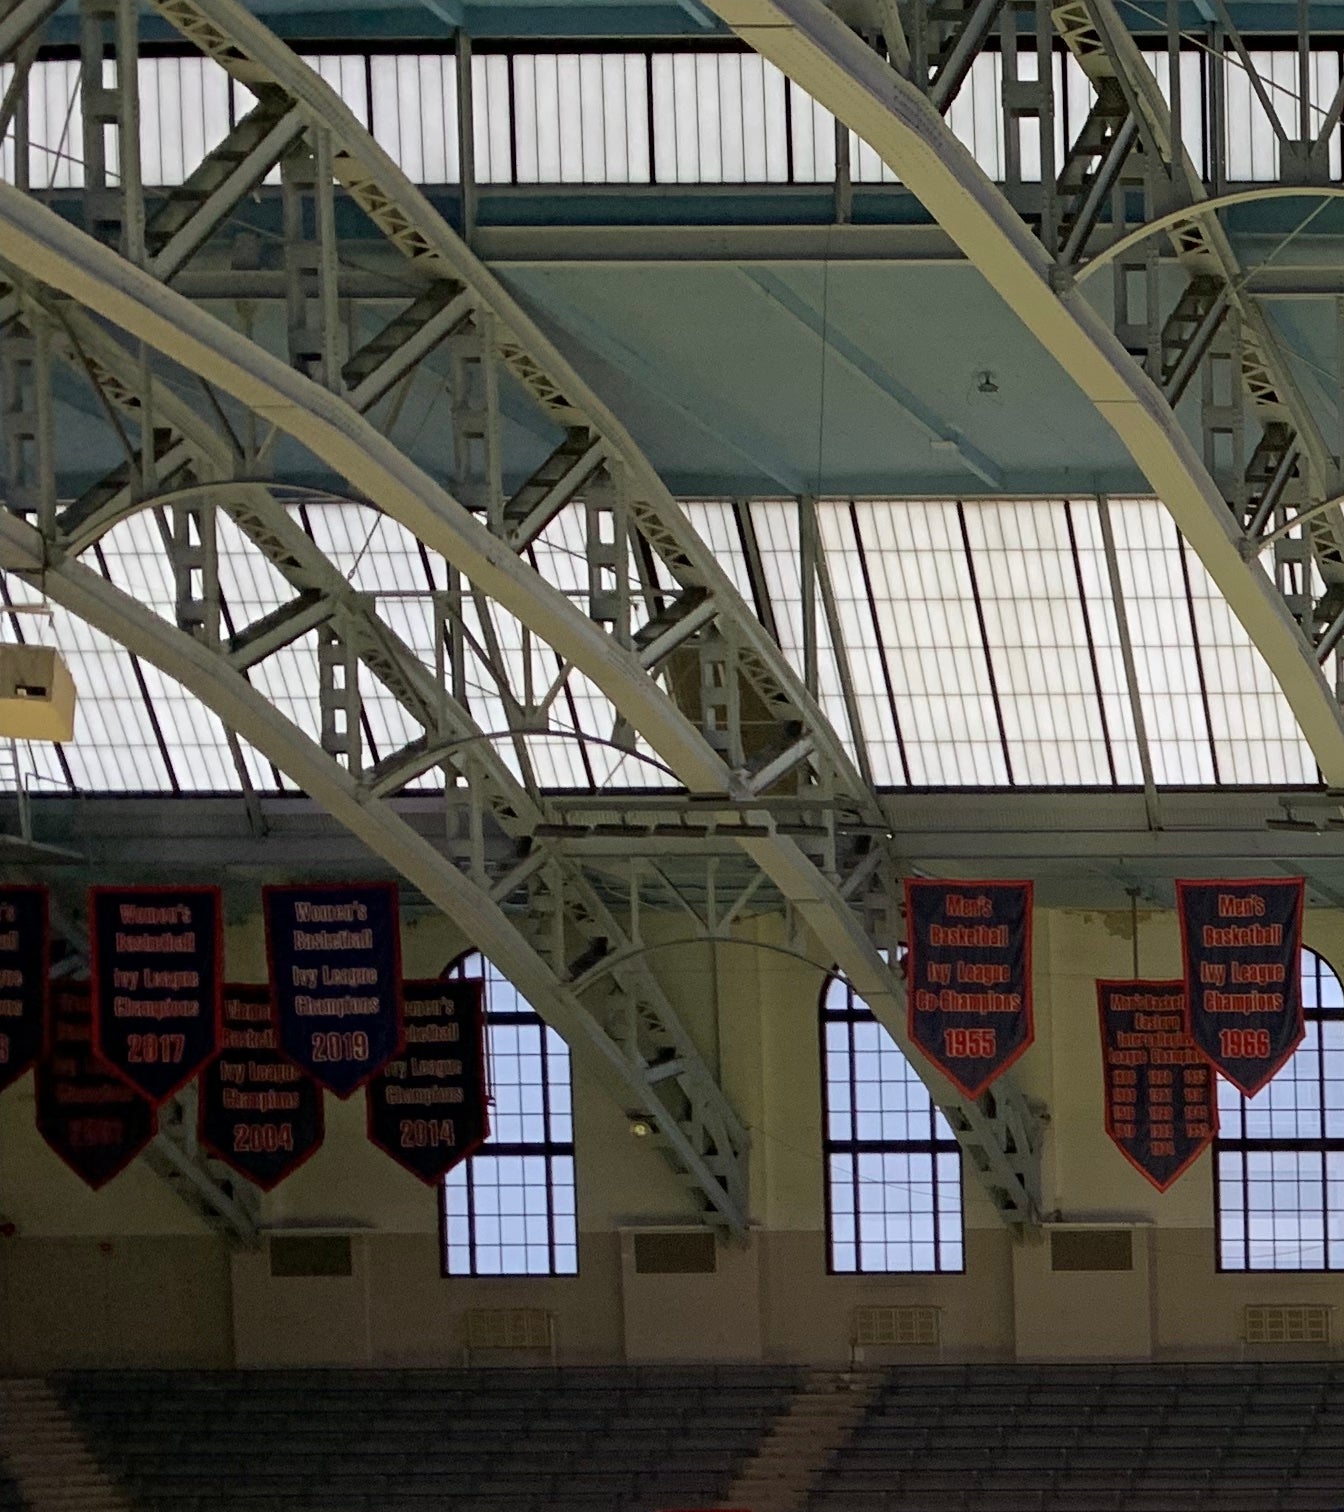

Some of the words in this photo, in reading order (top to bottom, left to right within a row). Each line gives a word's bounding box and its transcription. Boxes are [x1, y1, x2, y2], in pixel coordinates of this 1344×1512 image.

[119, 903, 192, 925] Women's
[295, 901, 368, 922] Women's
[945, 895, 993, 917] Men's
[1218, 894, 1265, 917] Men's
[115, 931, 196, 953] Basketball
[293, 928, 373, 950] Basketball
[930, 925, 1009, 947] Basketball
[1203, 924, 1283, 947] Basketball
[113, 967, 140, 991] Ivy
[143, 967, 200, 991] League
[291, 965, 318, 989] Ivy
[321, 965, 378, 988] League
[927, 962, 951, 985] Ivy
[956, 962, 1011, 985] League
[1200, 963, 1226, 986] Ivy
[1231, 961, 1285, 984] League
[113, 995, 201, 1021] Champions
[294, 995, 380, 1018] Champions
[1204, 990, 1284, 1015] Champions
[126, 1032, 187, 1064] 2017
[311, 1031, 370, 1062] 2019
[943, 1028, 996, 1058] 1955
[1219, 1029, 1270, 1058] 1966
[232, 1123, 294, 1152] 2004
[400, 1119, 455, 1148] 2014
